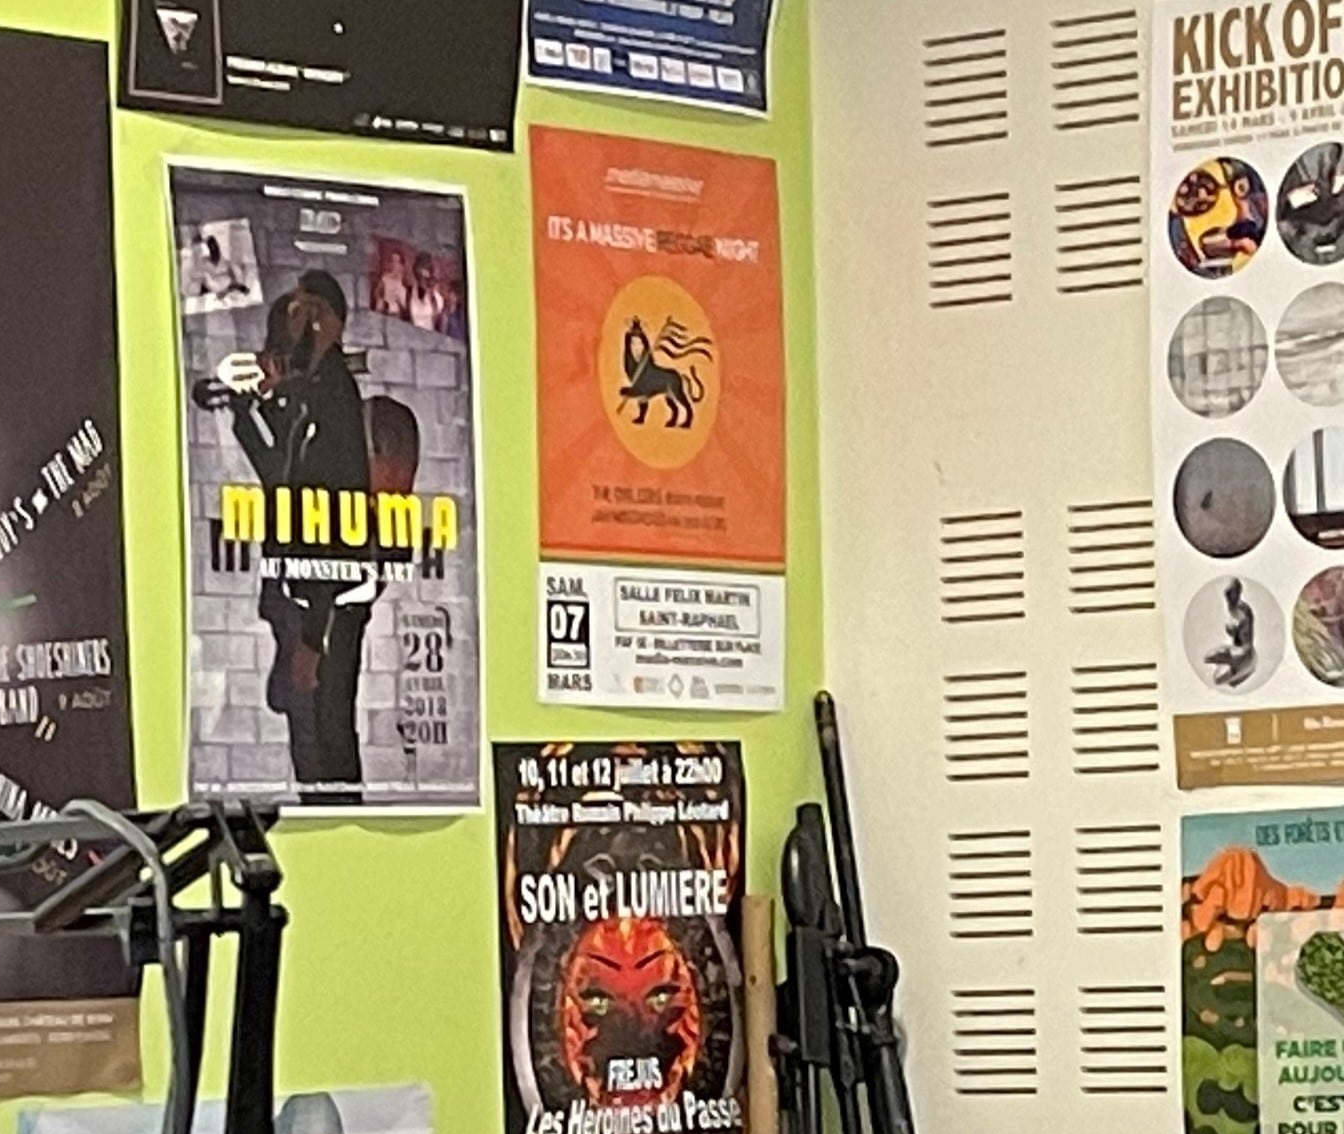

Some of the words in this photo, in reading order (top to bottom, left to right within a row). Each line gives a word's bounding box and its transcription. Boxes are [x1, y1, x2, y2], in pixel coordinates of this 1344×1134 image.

[1173, 2, 1274, 77] KICK
[1242, 112, 1275, 128] MARS
[222, 484, 457, 551] MIHUMA
[259, 557, 281, 579] AU
[284, 558, 377, 582] MONSTER'S
[382, 561, 415, 583] ART
[620, 585, 660, 602] SALLE
[550, 603, 586, 641] 07
[403, 630, 444, 673] 28
[546, 672, 592, 692] MARS
[572, 759, 589, 786] et
[592, 756, 611, 786] 12
[613, 755, 659, 792] juillet
[1255, 823, 1281, 846] DES
[1284, 814, 1333, 845] FORÊTS
[520, 872, 576, 924] SON
[583, 875, 609, 920] et
[616, 868, 728, 920] LUMIERE
[1274, 1038, 1338, 1060] FAIRE
[658, 1098, 683, 1134] du
